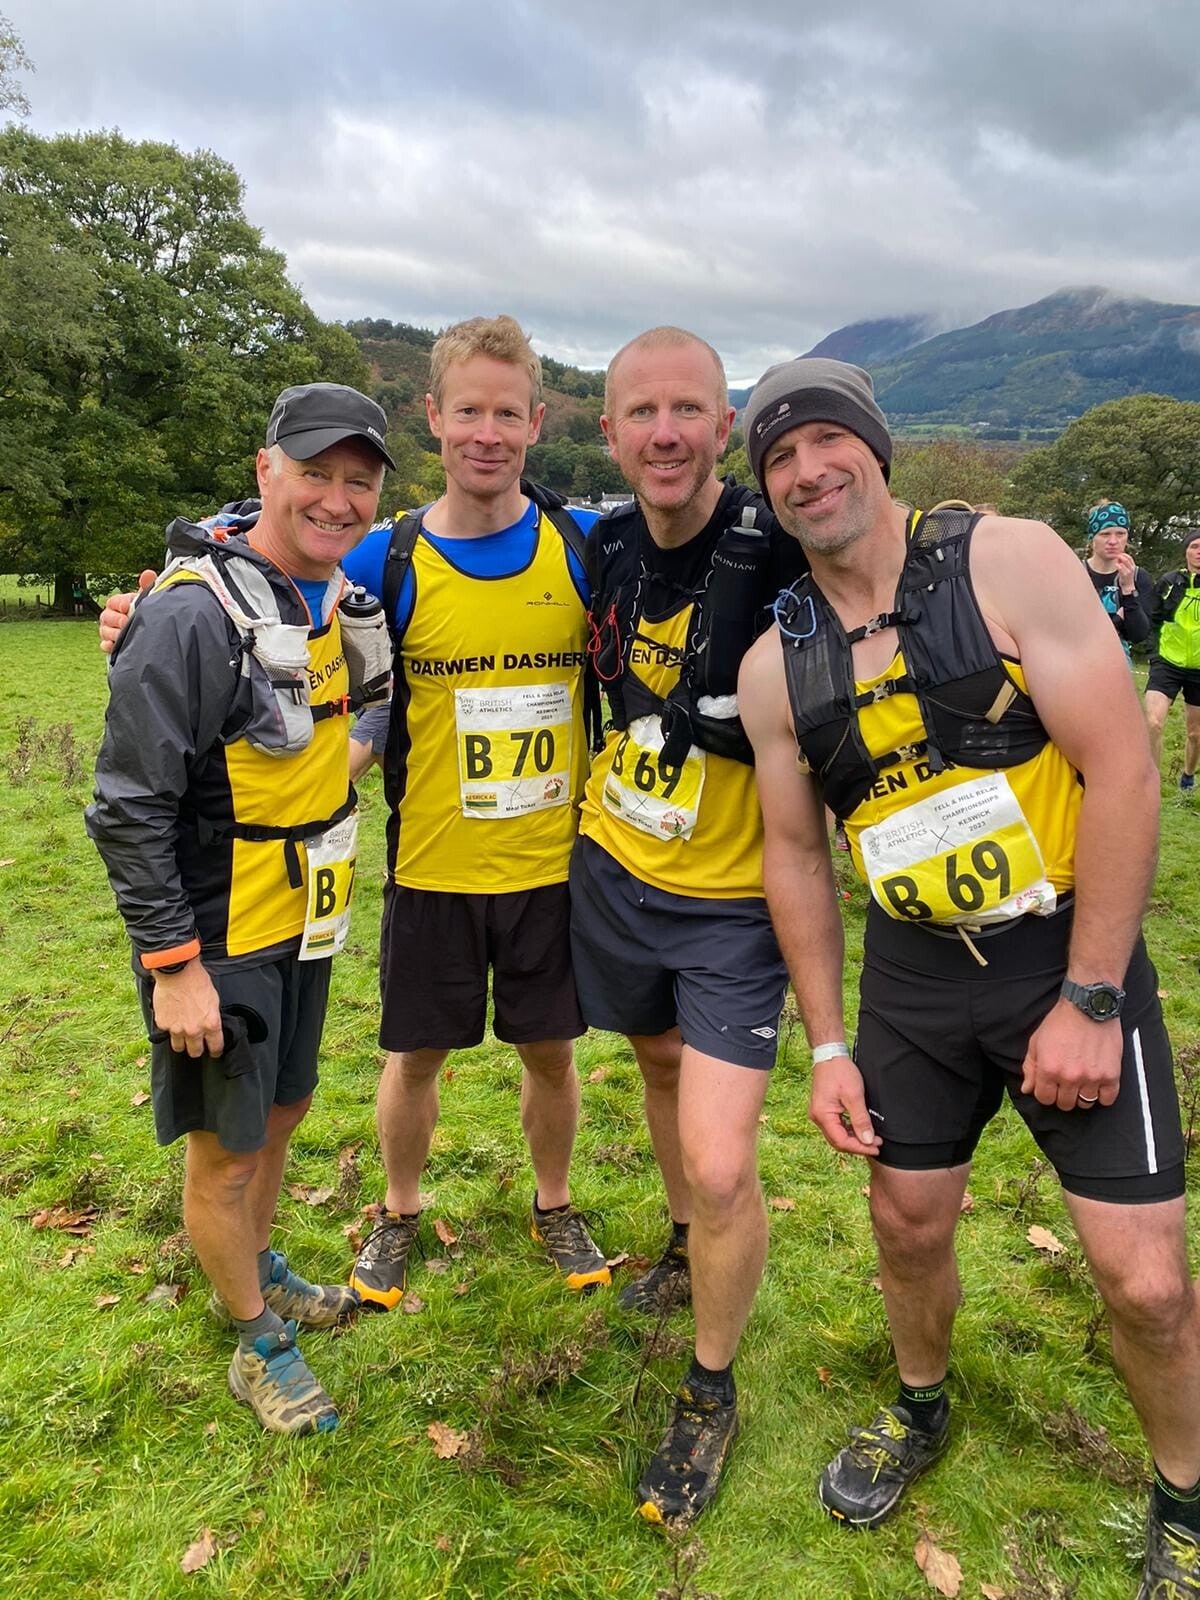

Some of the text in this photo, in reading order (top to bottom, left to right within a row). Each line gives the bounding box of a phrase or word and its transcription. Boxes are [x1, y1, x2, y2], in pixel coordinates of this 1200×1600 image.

[410, 655, 495, 676] DARWEN
[479, 698, 513, 707] BRITISH
[465, 728, 555, 779] B 70
[634, 751, 683, 799] 69
[934, 801, 951, 812] FELL
[958, 792, 975, 802] HILL
[975, 786, 999, 797] RELAY
[941, 794, 1000, 821] CHAMPIONSHIPS
[958, 809, 992, 826] KESWICK
[968, 821, 987, 832] 2023
[884, 821, 925, 841] BRITISH
[887, 828, 928, 849] ATHLETICS
[881, 875, 933, 920] B
[946, 840, 1011, 911] 69
[315, 868, 336, 918] B
